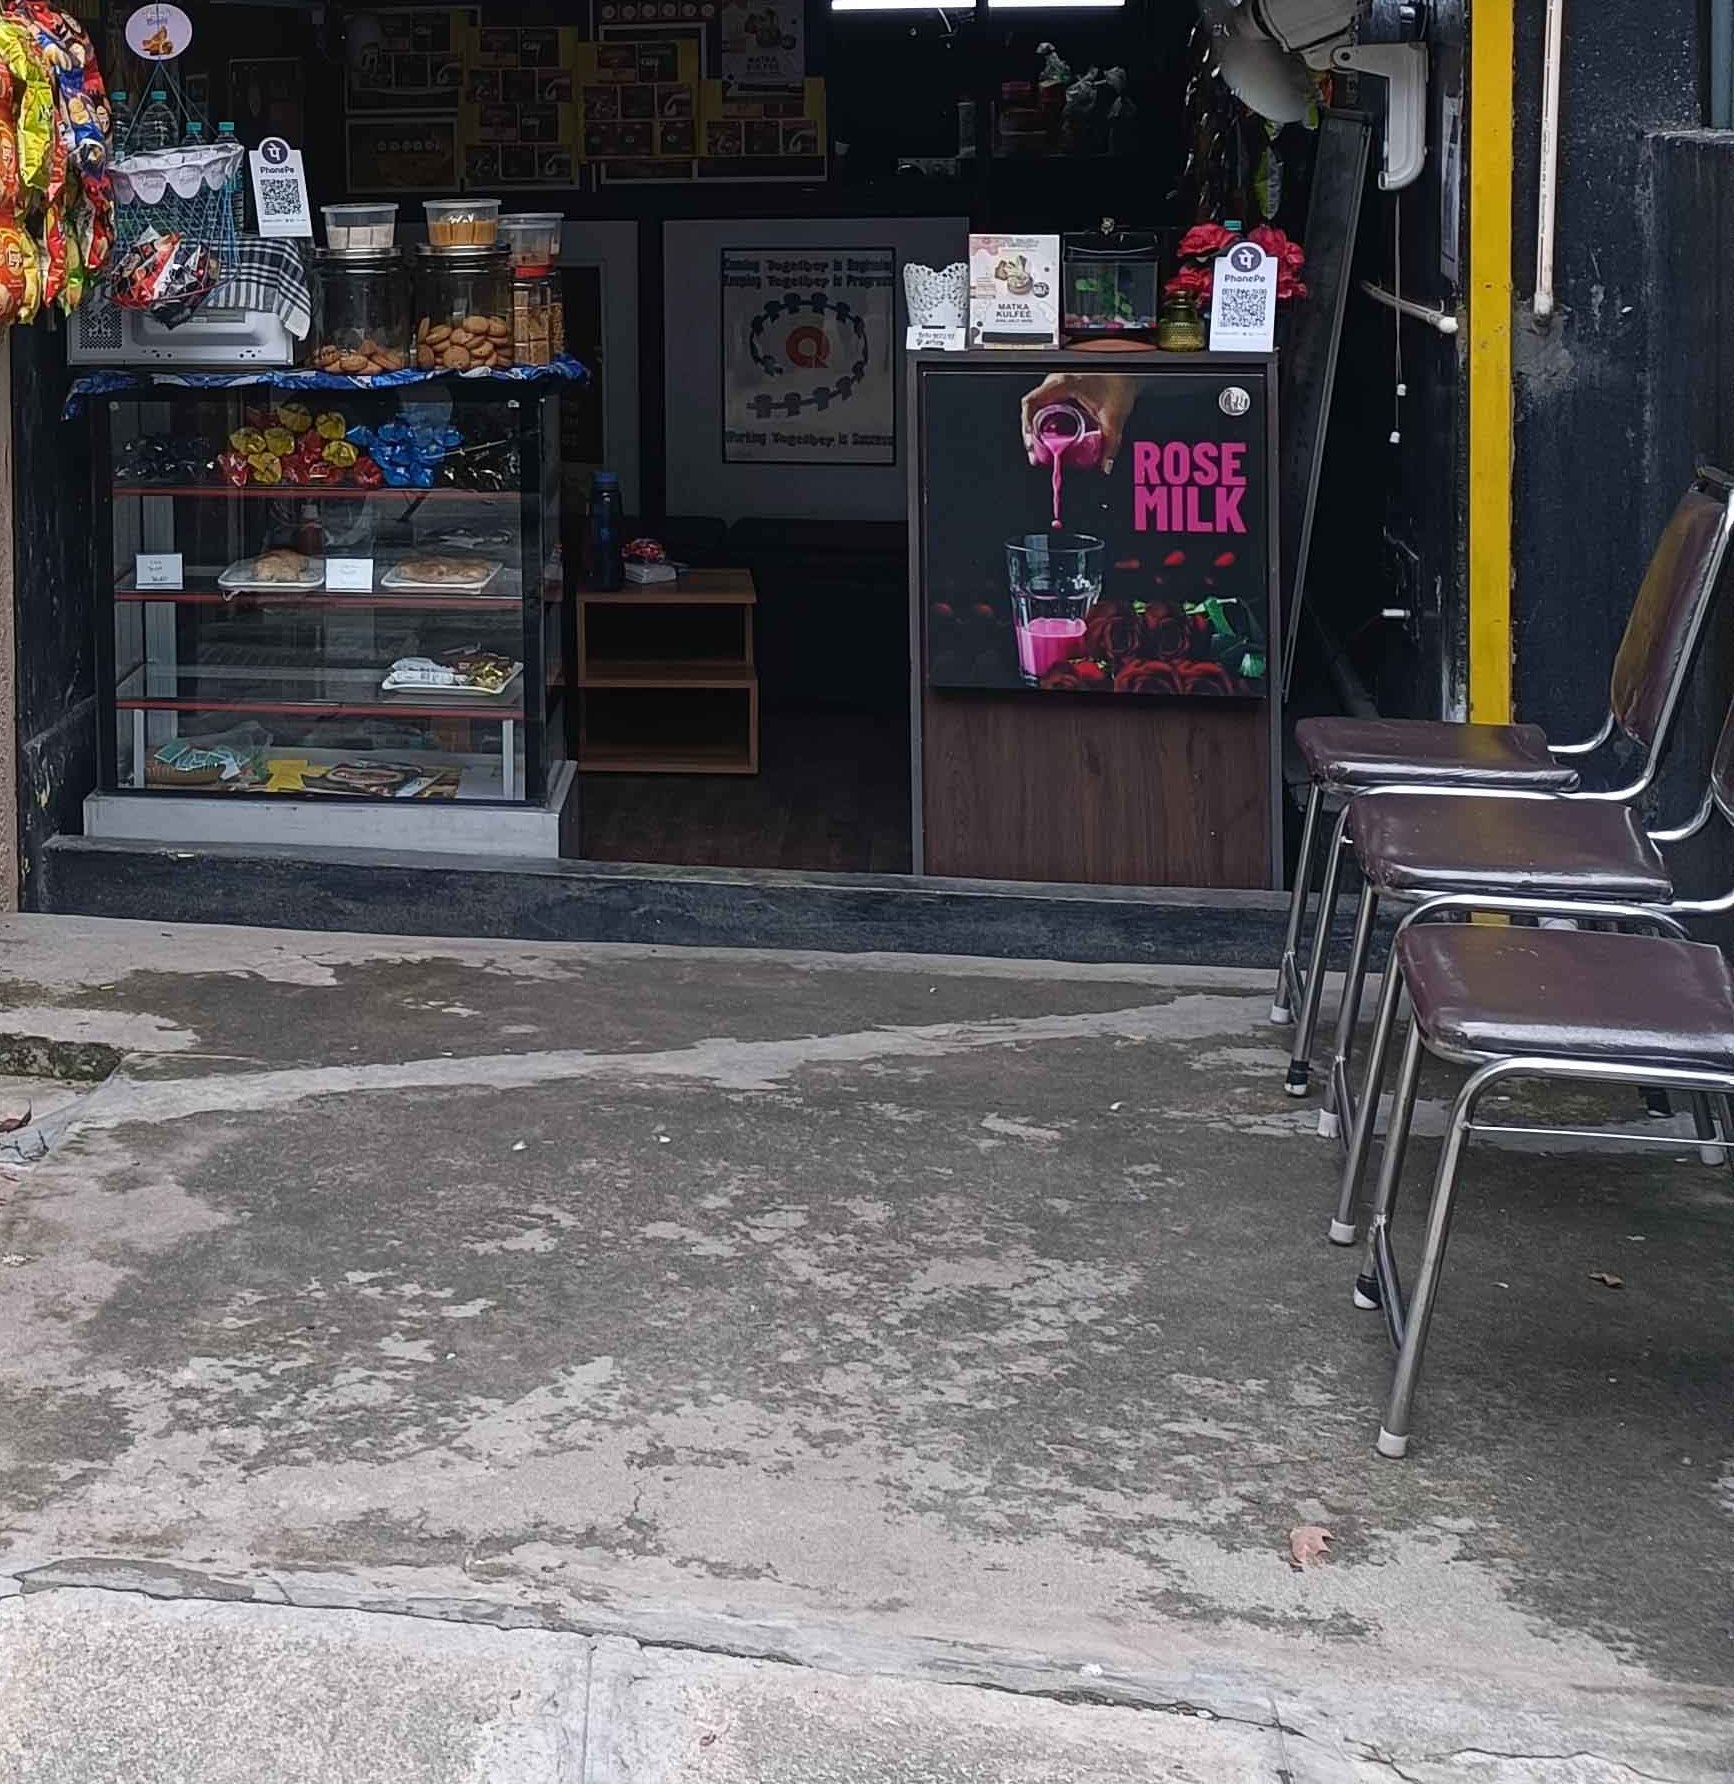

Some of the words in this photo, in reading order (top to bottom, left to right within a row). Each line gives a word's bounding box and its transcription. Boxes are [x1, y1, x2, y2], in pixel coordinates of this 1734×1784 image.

[260, 166, 295, 174] PhonePe
[1224, 274, 1266, 283] PhonePe
[997, 303, 1030, 311] MATKA
[1133, 441, 1247, 486] ROSE
[1133, 486, 1247, 533] MILK
